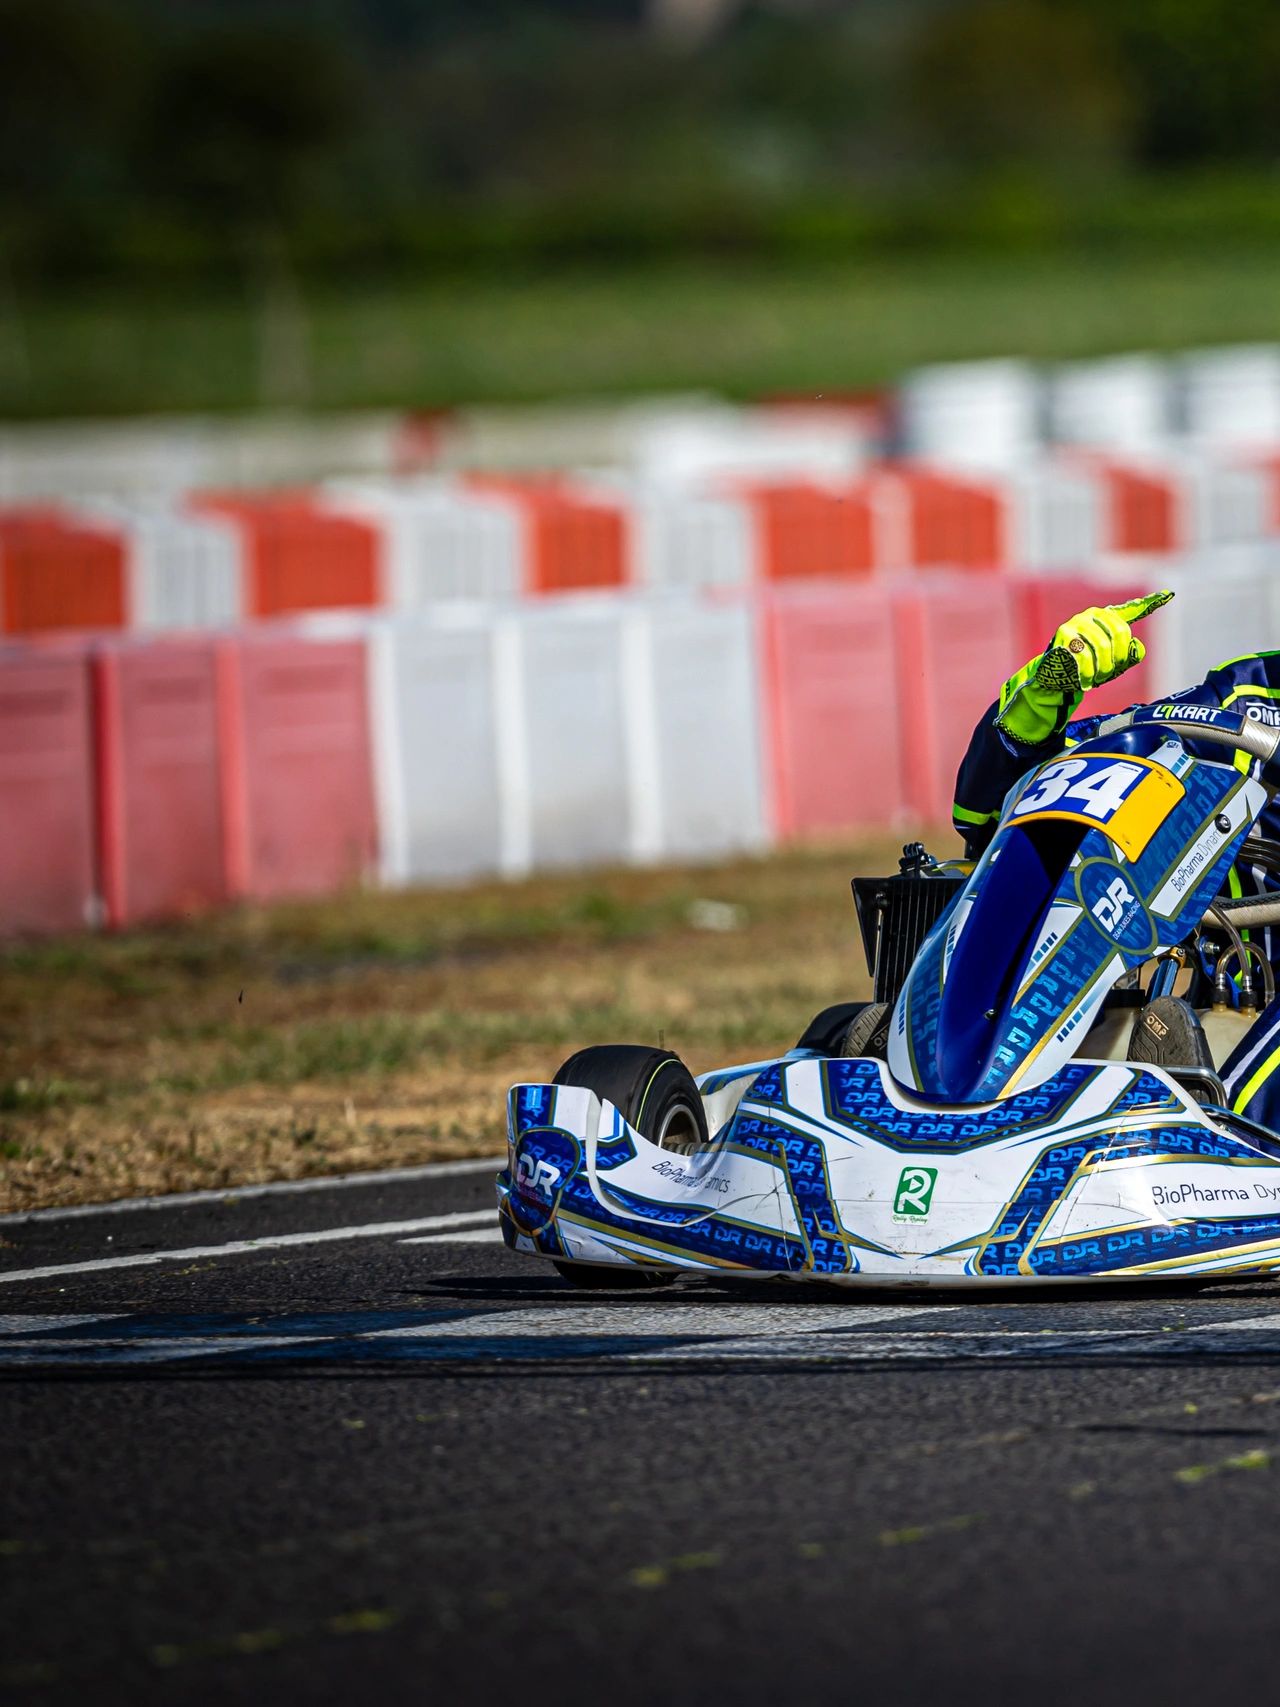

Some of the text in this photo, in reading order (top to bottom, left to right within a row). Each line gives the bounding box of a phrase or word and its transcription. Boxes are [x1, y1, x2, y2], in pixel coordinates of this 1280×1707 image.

[1014, 759, 1144, 819] 34
[1171, 852, 1204, 892] BioPharma
[1092, 877, 1135, 933] DJR
[1147, 1015, 1168, 1037] OMP
[1014, 1096, 1050, 1107] DJR
[860, 1107, 896, 1118] DJR
[986, 1110, 1024, 1122] DJR
[917, 1123, 954, 1135] DJR
[1159, 1132, 1193, 1150] DJR
[1049, 1148, 1086, 1162] DJR
[519, 1153, 560, 1198] DJR
[1152, 1183, 1250, 1205] BioPharma
[1063, 1241, 1100, 1260] DJR
[1108, 1232, 1145, 1251] DJR
